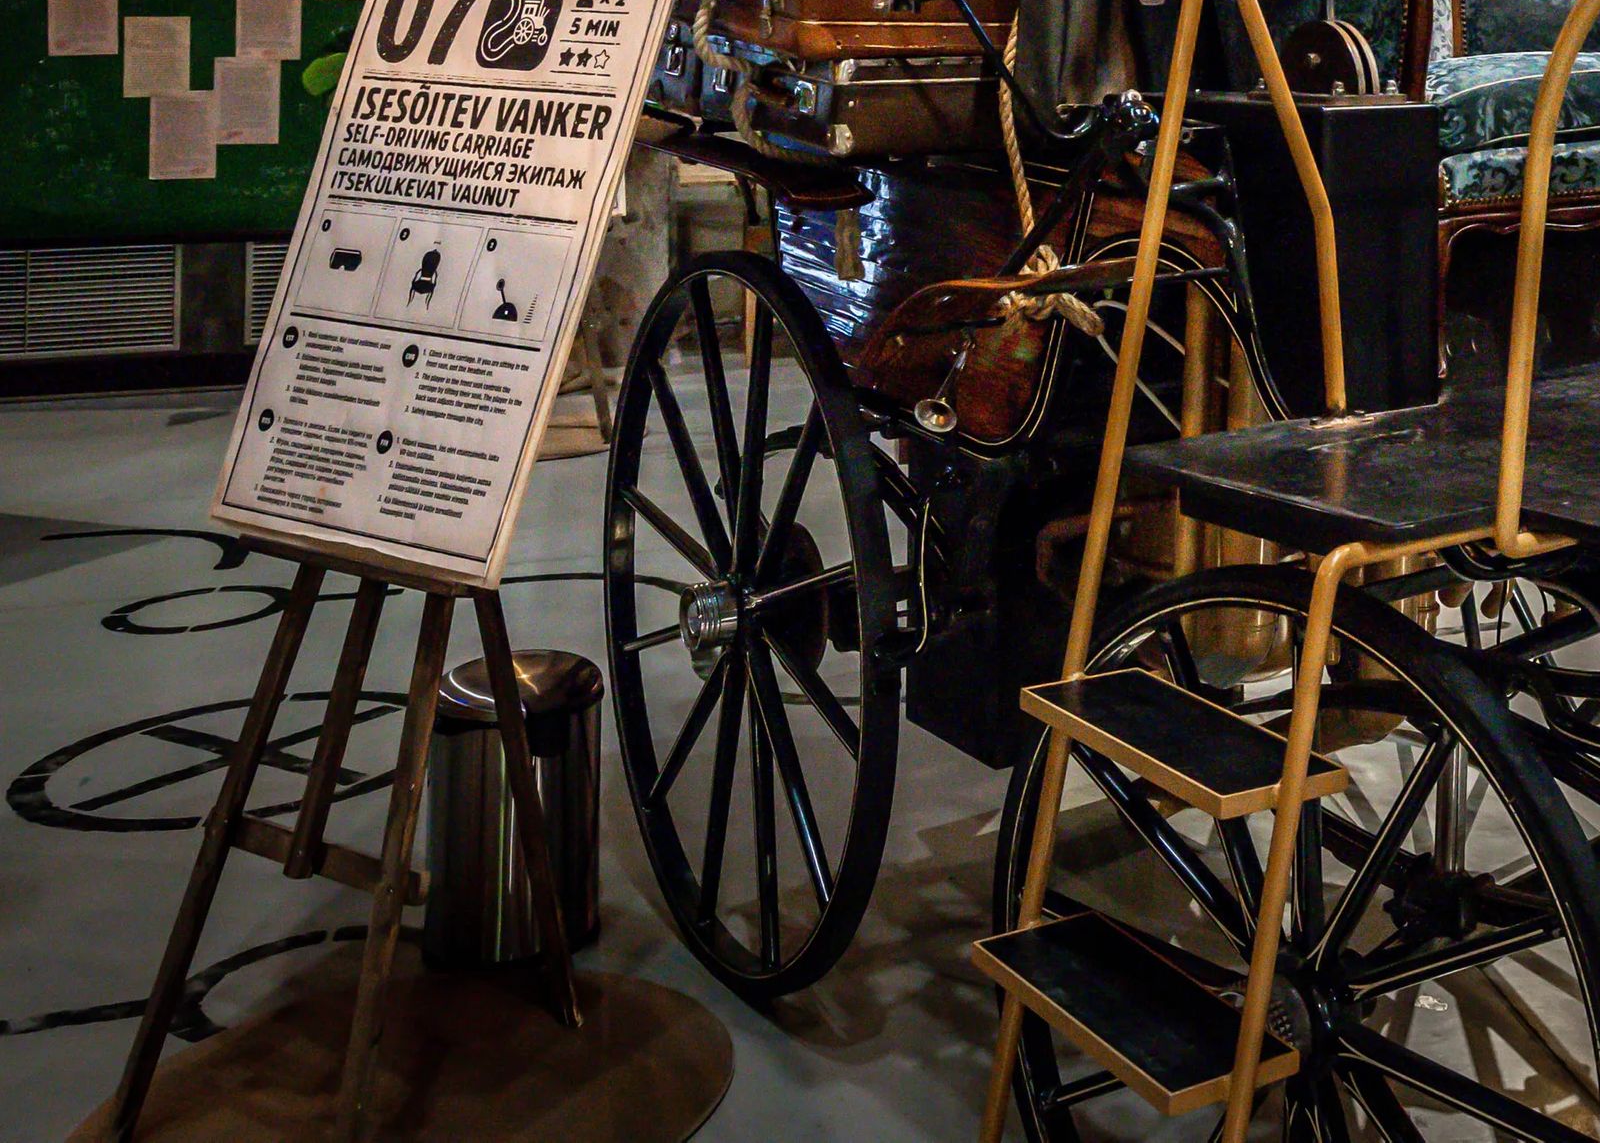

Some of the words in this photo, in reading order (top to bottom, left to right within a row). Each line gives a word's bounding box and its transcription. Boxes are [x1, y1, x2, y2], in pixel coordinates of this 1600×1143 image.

[569, 17, 582, 35] 5
[584, 19, 620, 37] MIN
[351, 84, 491, 130] ISESÕITEV
[495, 97, 612, 140] VANKER
[343, 122, 451, 151] SELF-DRIVING
[452, 133, 535, 159] CARRIAGE
[338, 147, 506, 181] САМОДВИЖУЩИЙСЯ
[506, 163, 586, 190] ЭКИПАЖ
[330, 171, 448, 200] ITSEKULKEVAT
[451, 183, 520, 208] VAUNUT
